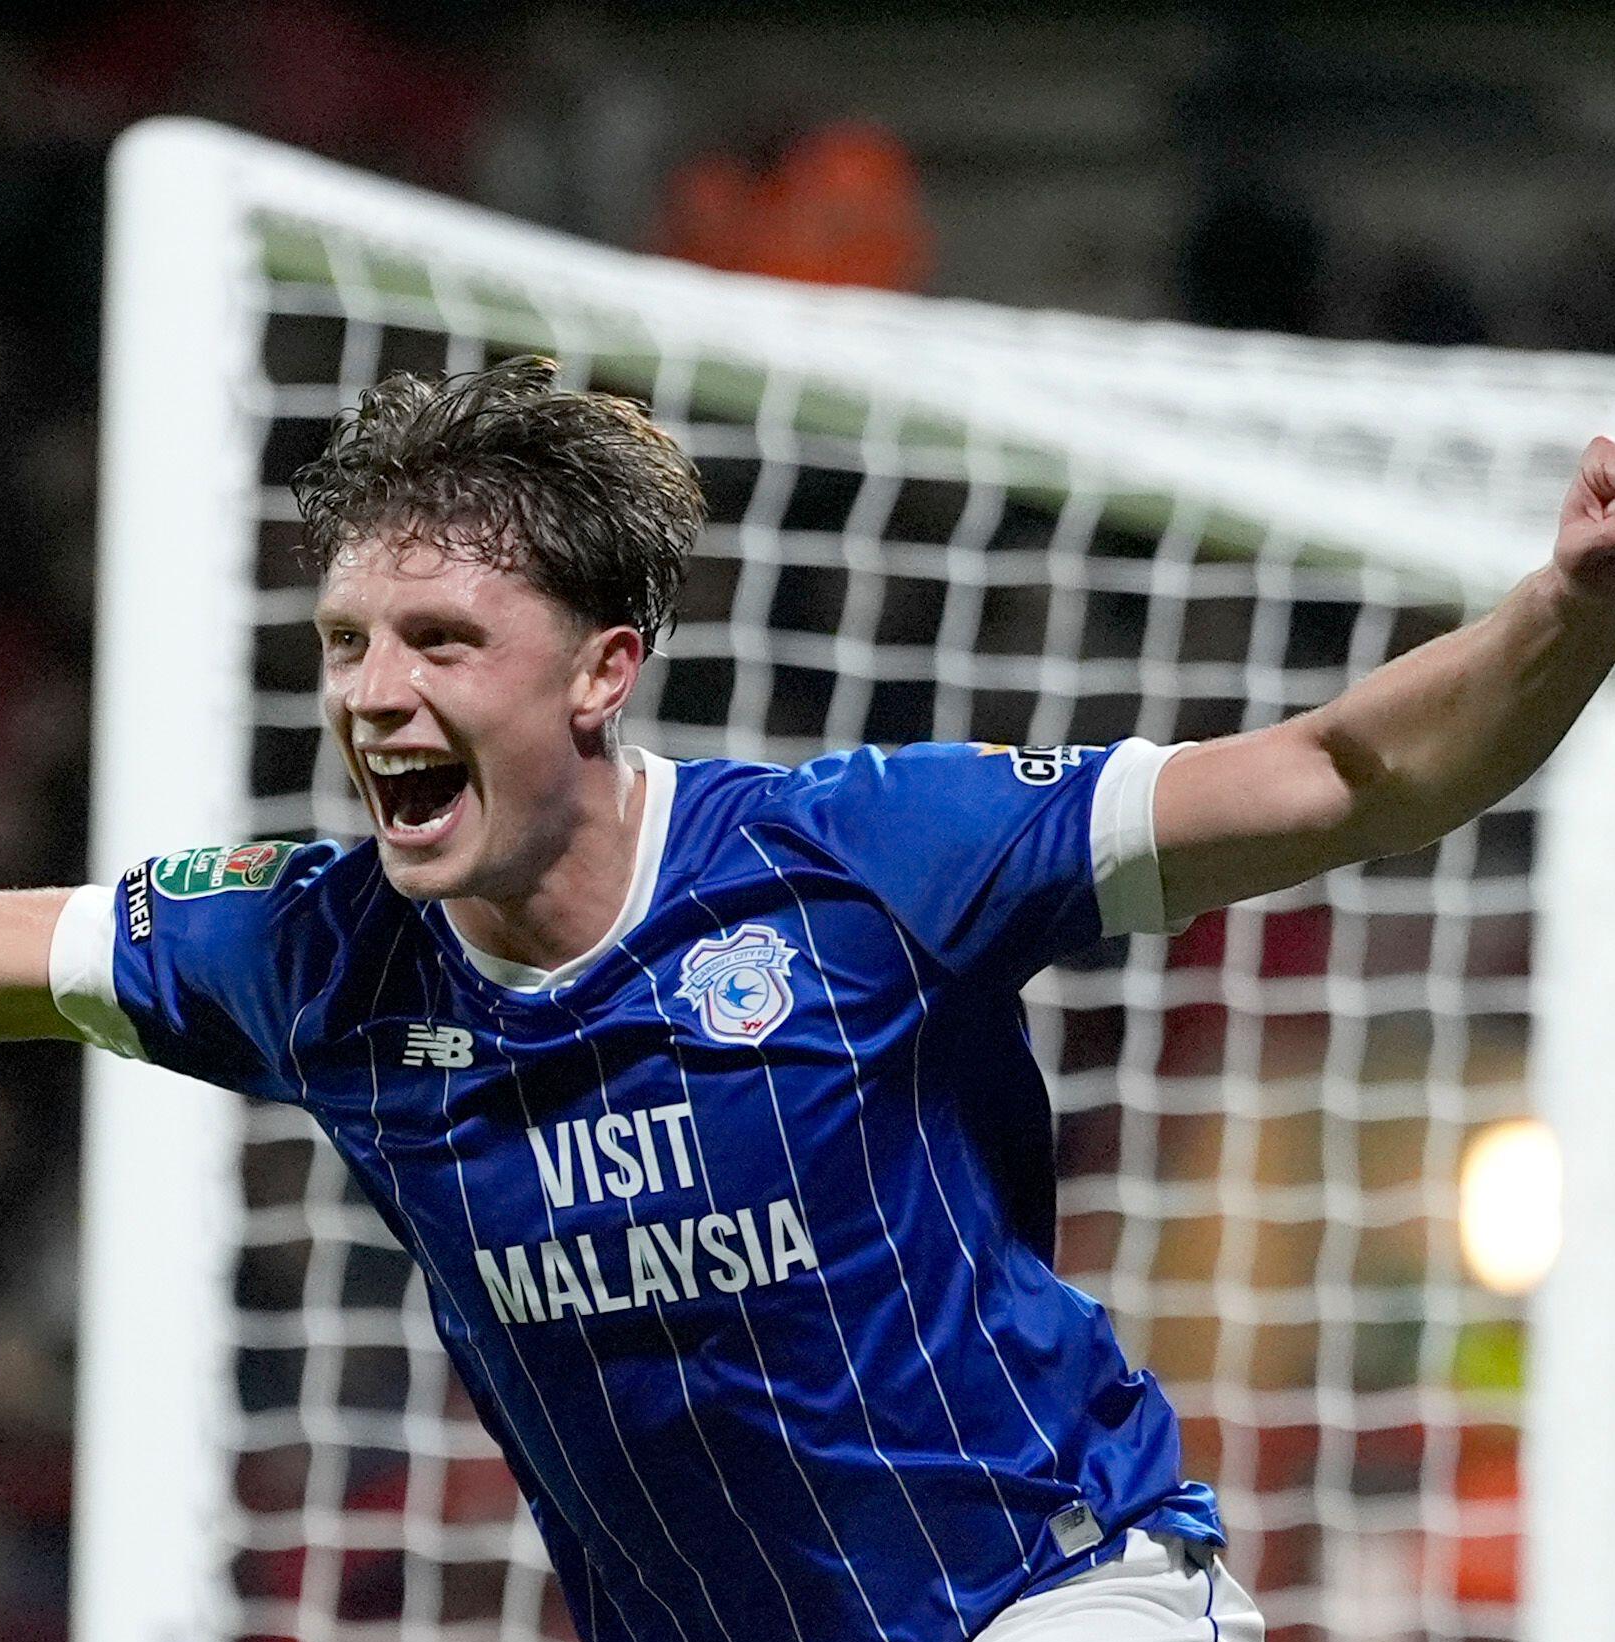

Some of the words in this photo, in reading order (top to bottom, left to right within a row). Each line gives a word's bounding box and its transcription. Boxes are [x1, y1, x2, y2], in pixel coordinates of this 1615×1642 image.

[734, 951, 755, 961] CITY
[402, 1023, 474, 1069] NB
[526, 1102, 695, 1208] VISIT
[473, 1198, 819, 1324] MALAYSIA
